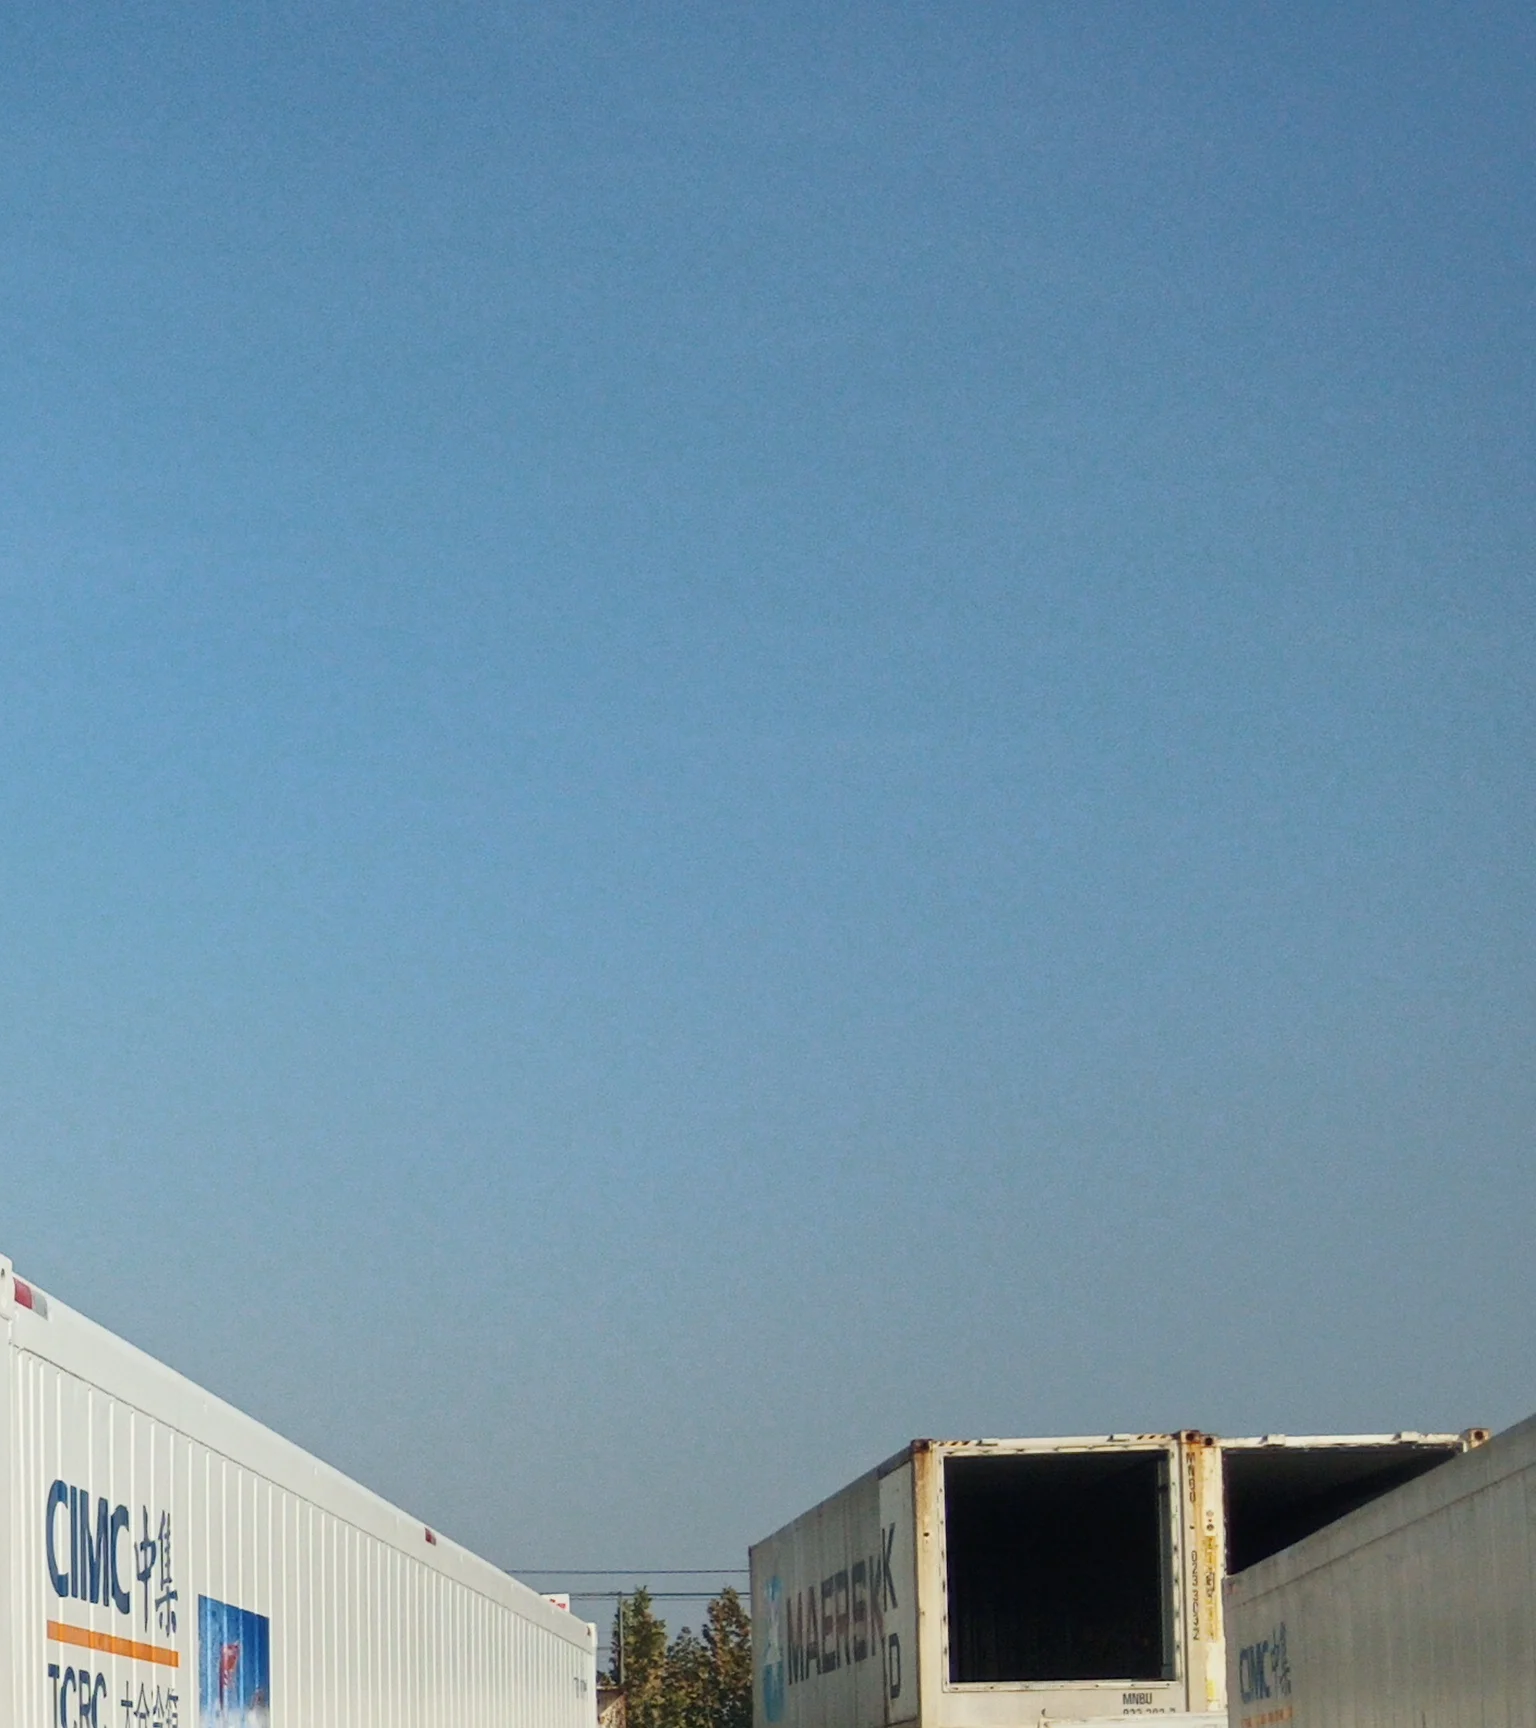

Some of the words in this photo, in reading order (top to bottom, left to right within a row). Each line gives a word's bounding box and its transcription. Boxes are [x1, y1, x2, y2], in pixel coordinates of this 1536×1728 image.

[46, 1479, 131, 1616] CIMC
[134, 1504, 179, 1638] 中集
[1122, 1693, 1153, 1705] MNBU
